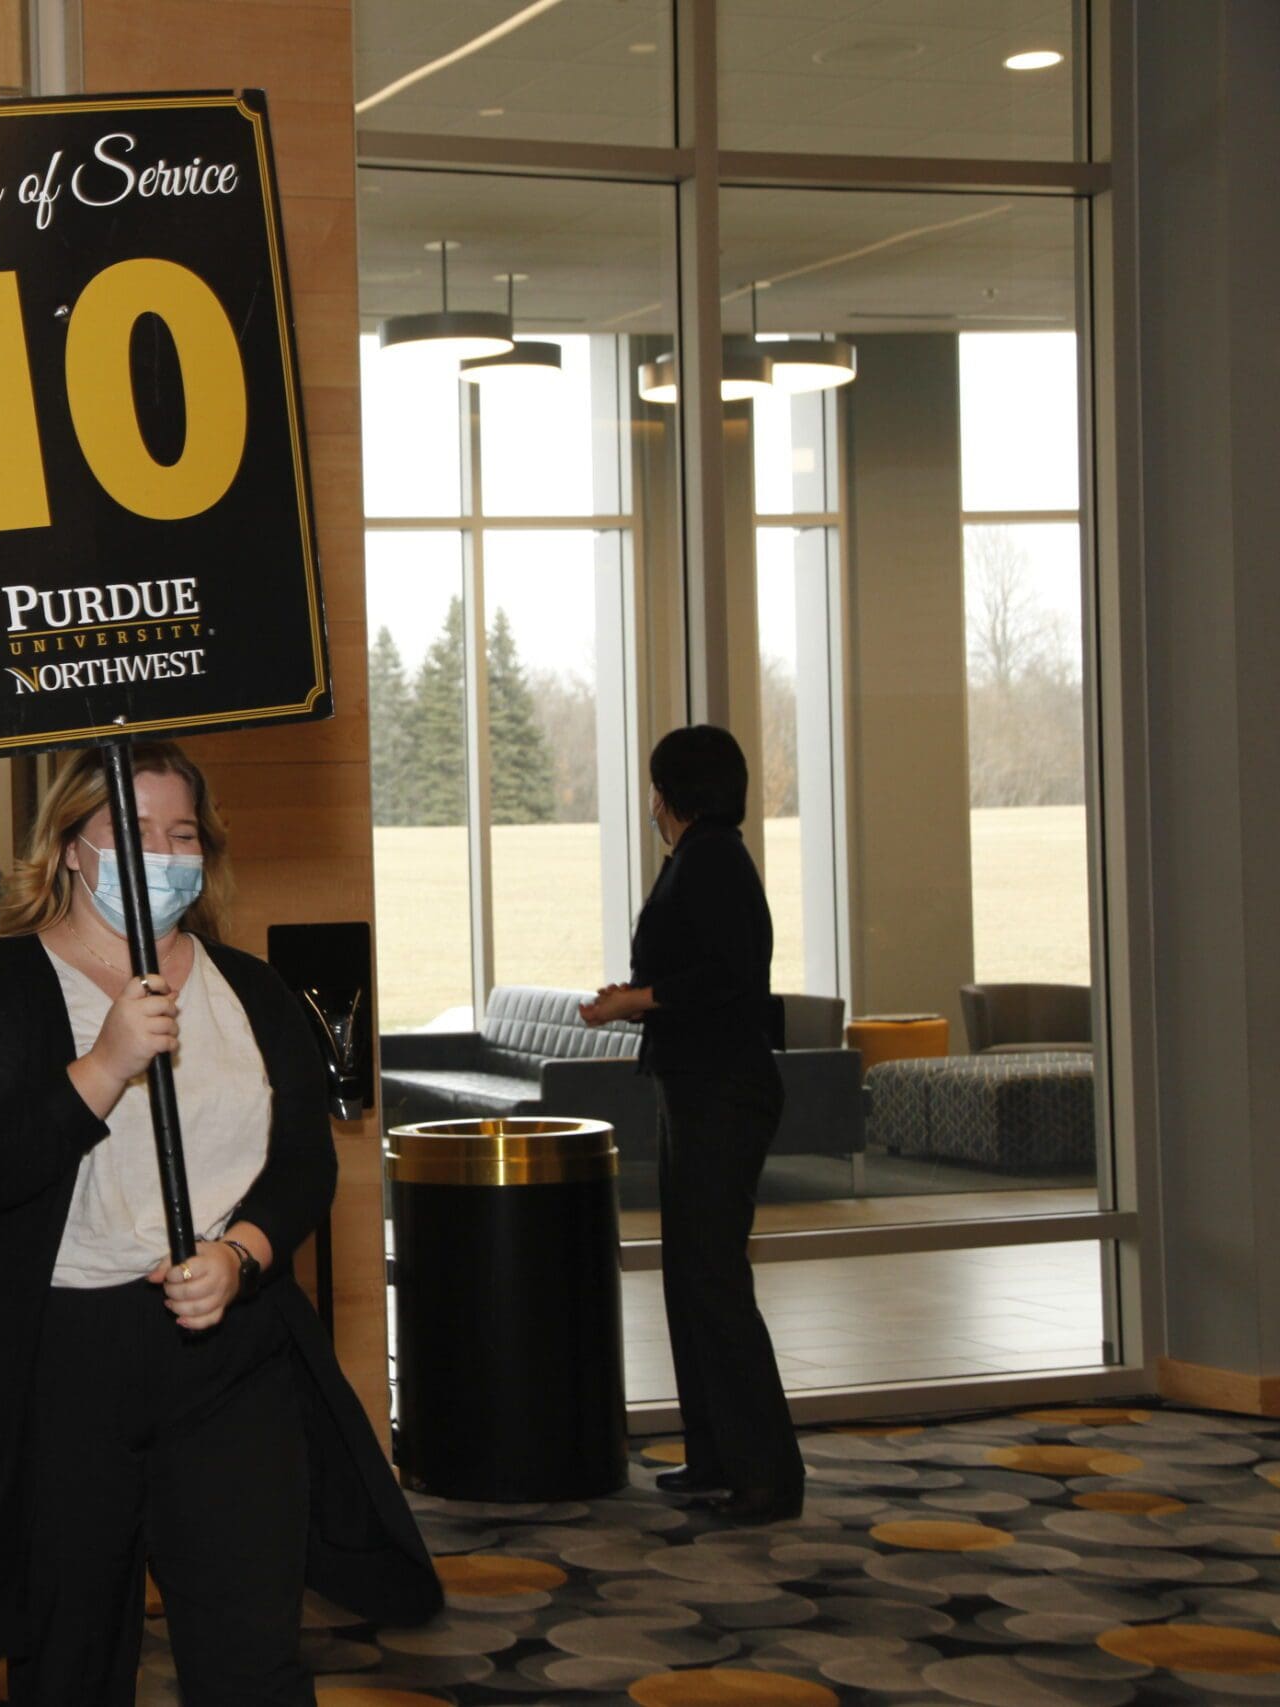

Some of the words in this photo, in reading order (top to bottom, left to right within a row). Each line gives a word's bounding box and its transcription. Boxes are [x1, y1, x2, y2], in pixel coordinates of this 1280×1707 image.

[17, 150, 64, 230] of
[70, 132, 240, 207] Service
[1, 577, 201, 632] PURDUE
[9, 623, 203, 656] UNIVERSITY
[5, 648, 206, 695] NORTHWEST
